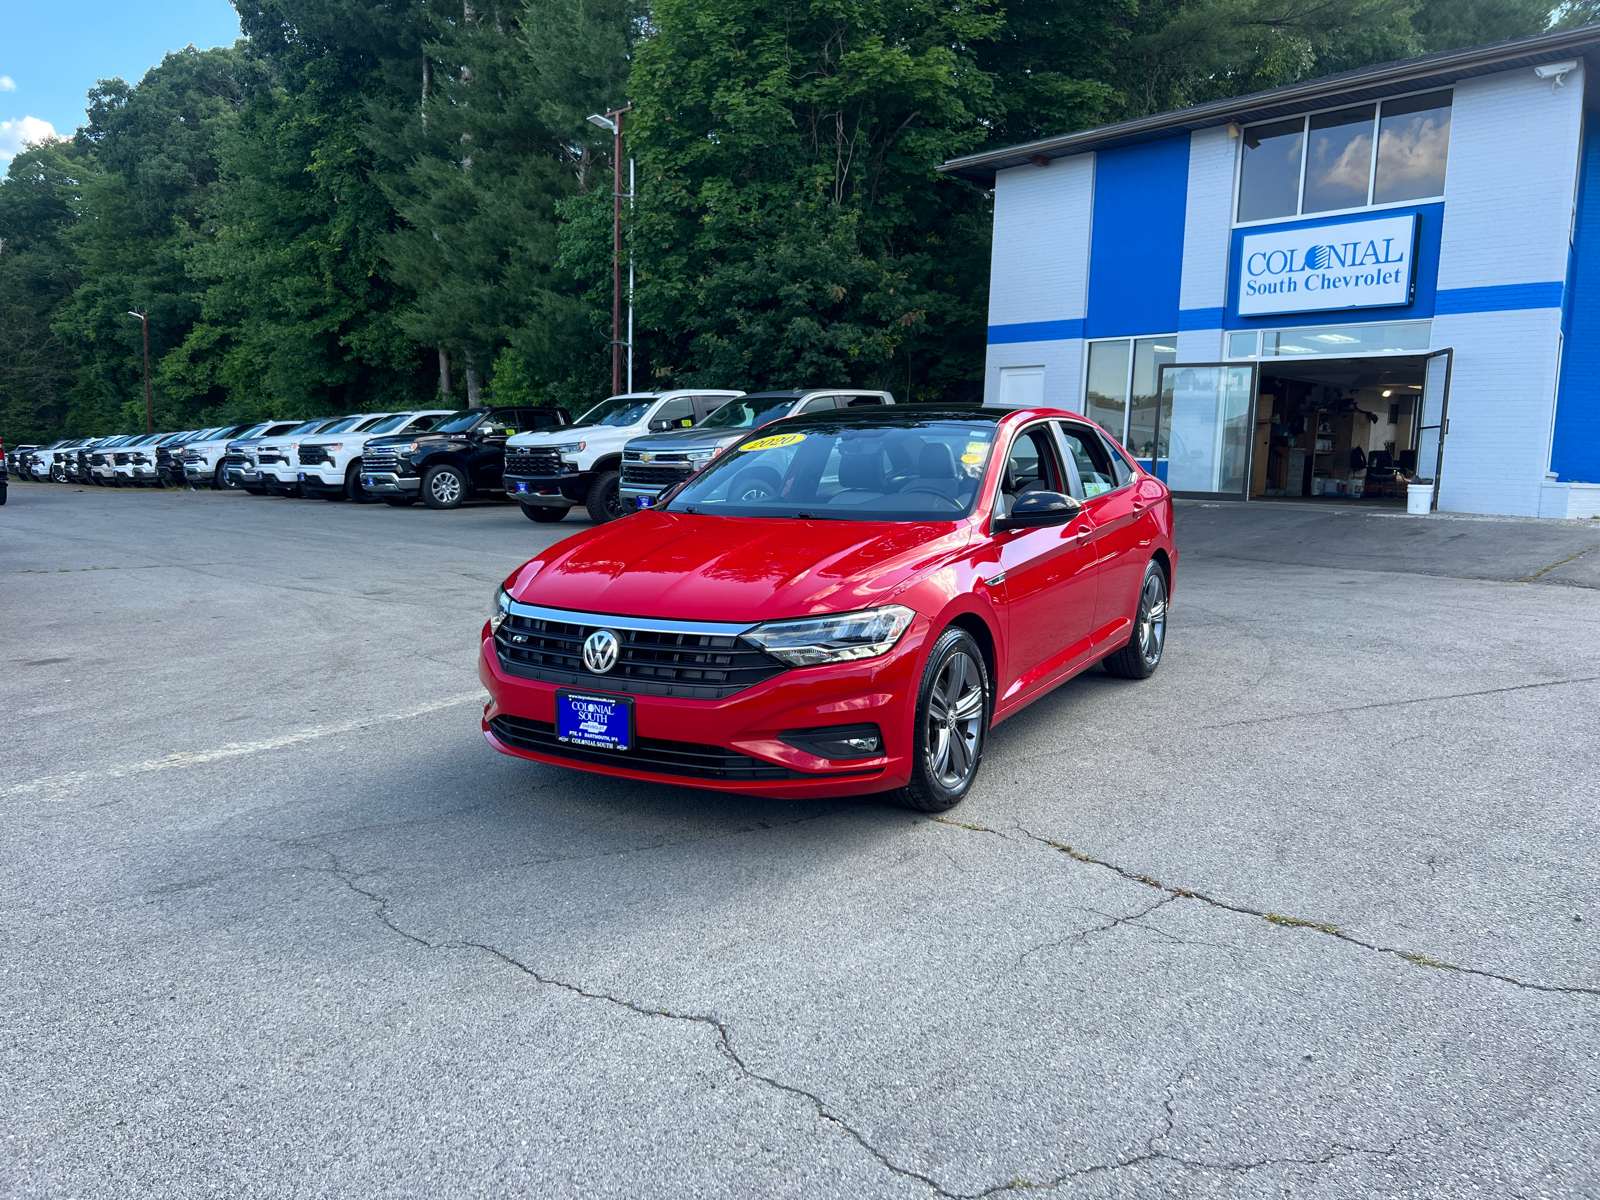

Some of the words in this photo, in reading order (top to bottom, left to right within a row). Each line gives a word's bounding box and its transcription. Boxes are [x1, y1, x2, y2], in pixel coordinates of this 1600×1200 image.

[1247, 238, 1404, 276] COLONIAL
[1246, 276, 1297, 296] South
[1304, 267, 1402, 292] Chevrolet
[747, 435, 797, 449] 2020
[571, 701, 614, 715] COLONIAL
[578, 712, 608, 723] SOUTH
[581, 723, 605, 731] CHEVROLET
[571, 737, 596, 747] COLONIAL
[596, 741, 614, 750] SOUTH
